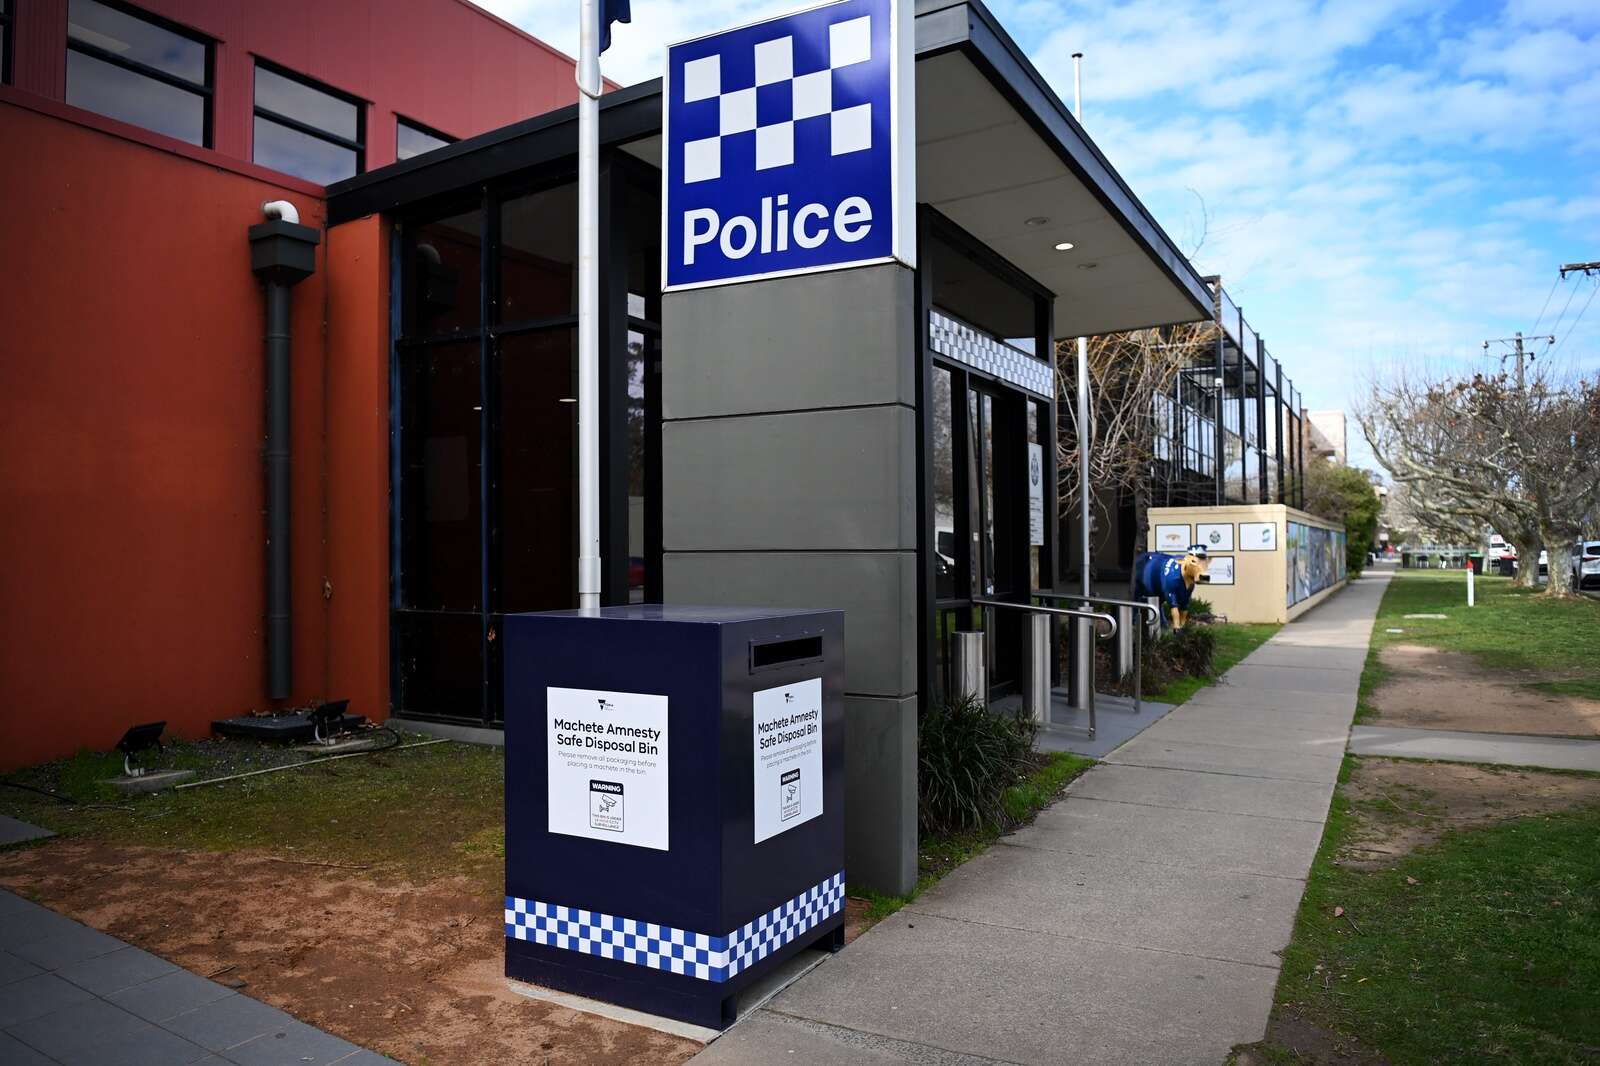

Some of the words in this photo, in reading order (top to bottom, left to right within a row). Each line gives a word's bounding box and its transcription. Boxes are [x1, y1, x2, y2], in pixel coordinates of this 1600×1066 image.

[683, 194, 873, 266] Police
[554, 718, 604, 734] Machete
[606, 723, 661, 742] Amnesty
[758, 718, 789, 734] Machete
[790, 709, 819, 725] Amnesty
[557, 733, 582, 747] Safe
[585, 736, 636, 752] Disposal
[639, 742, 658, 755] Bin
[760, 735, 777, 749] Safe
[778, 726, 807, 743] Disposal
[807, 723, 818, 735] Bin
[558, 751, 576, 759] Please
[577, 753, 597, 761] remove
[606, 756, 636, 766] packaging
[637, 759, 657, 768] before
[567, 760, 588, 769] placing
[593, 763, 619, 773] machete
[625, 766, 635, 774] the
[592, 783, 621, 792] WARNING
